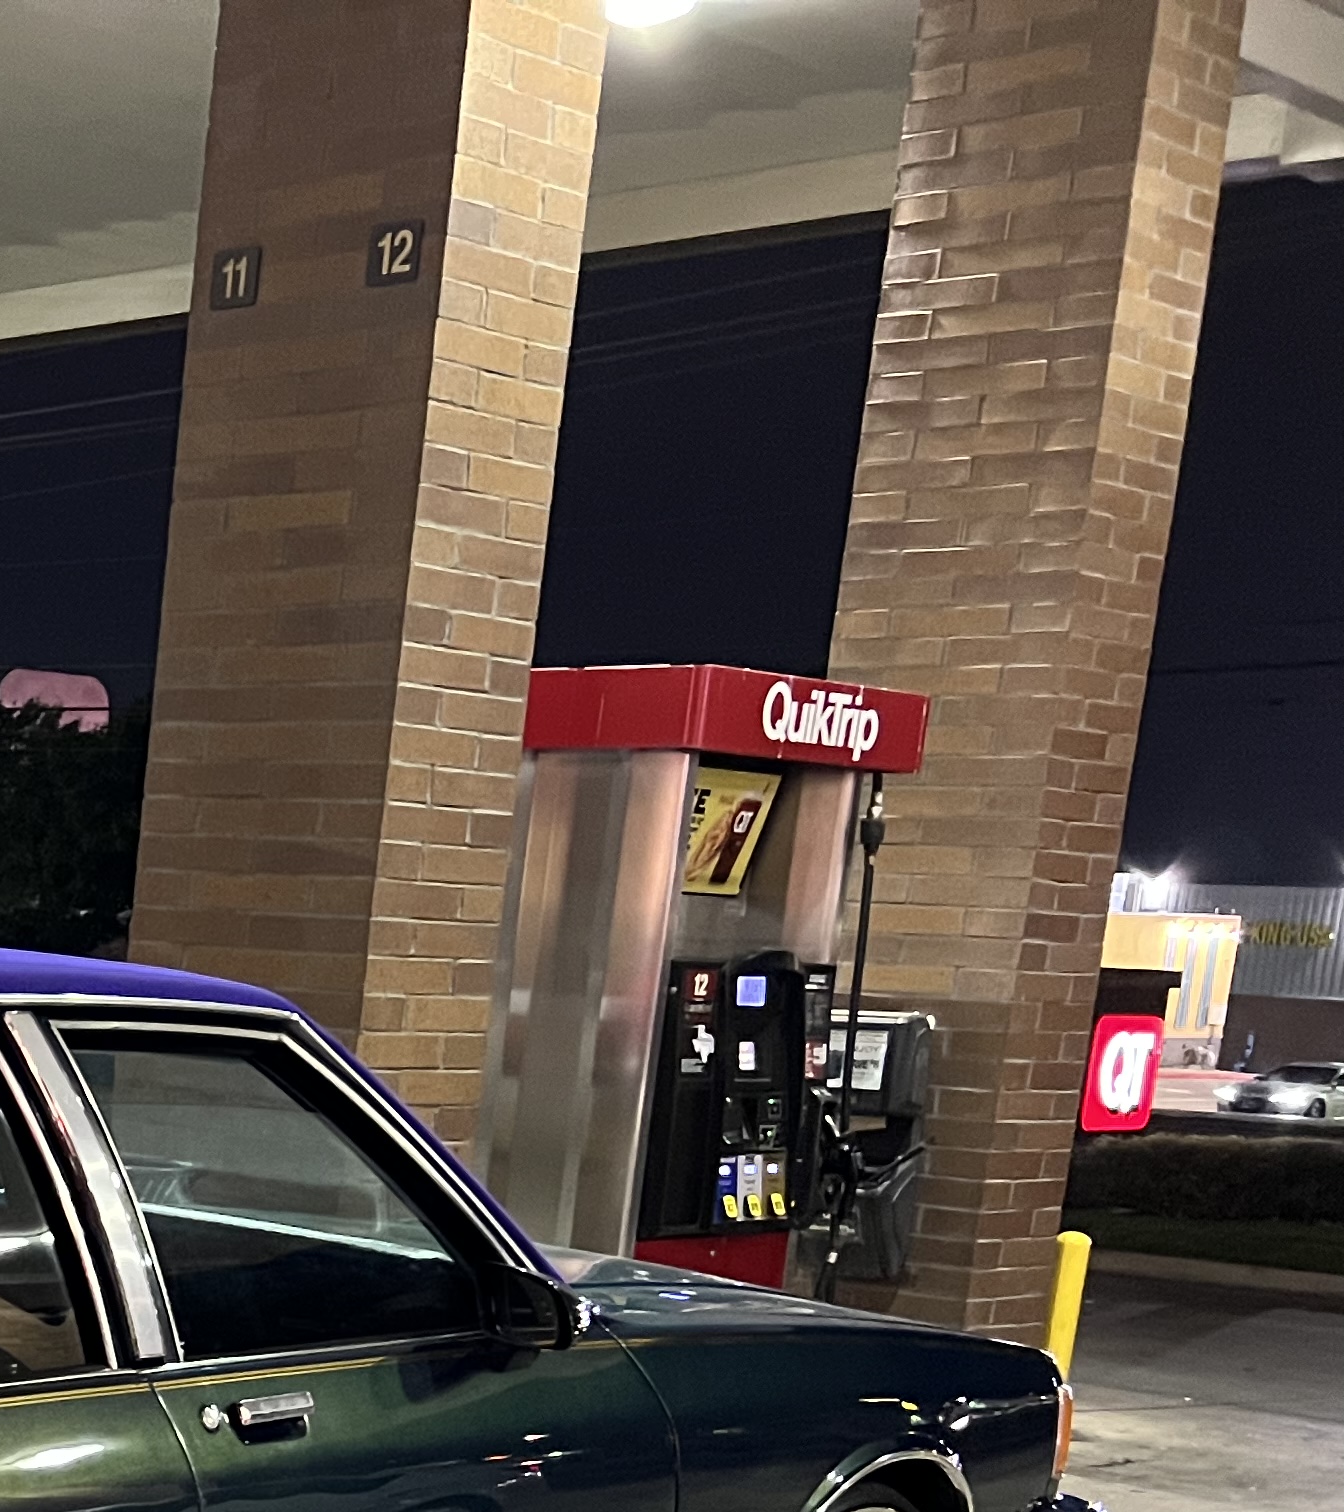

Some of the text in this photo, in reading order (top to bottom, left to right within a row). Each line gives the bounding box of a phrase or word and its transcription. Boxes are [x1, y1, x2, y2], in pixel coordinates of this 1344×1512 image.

[377, 229, 414, 276] 12
[222, 256, 248, 299] 11
[762, 681, 879, 762] QuikTrip
[694, 973, 709, 996] 12
[1099, 1031, 1155, 1113] QT
